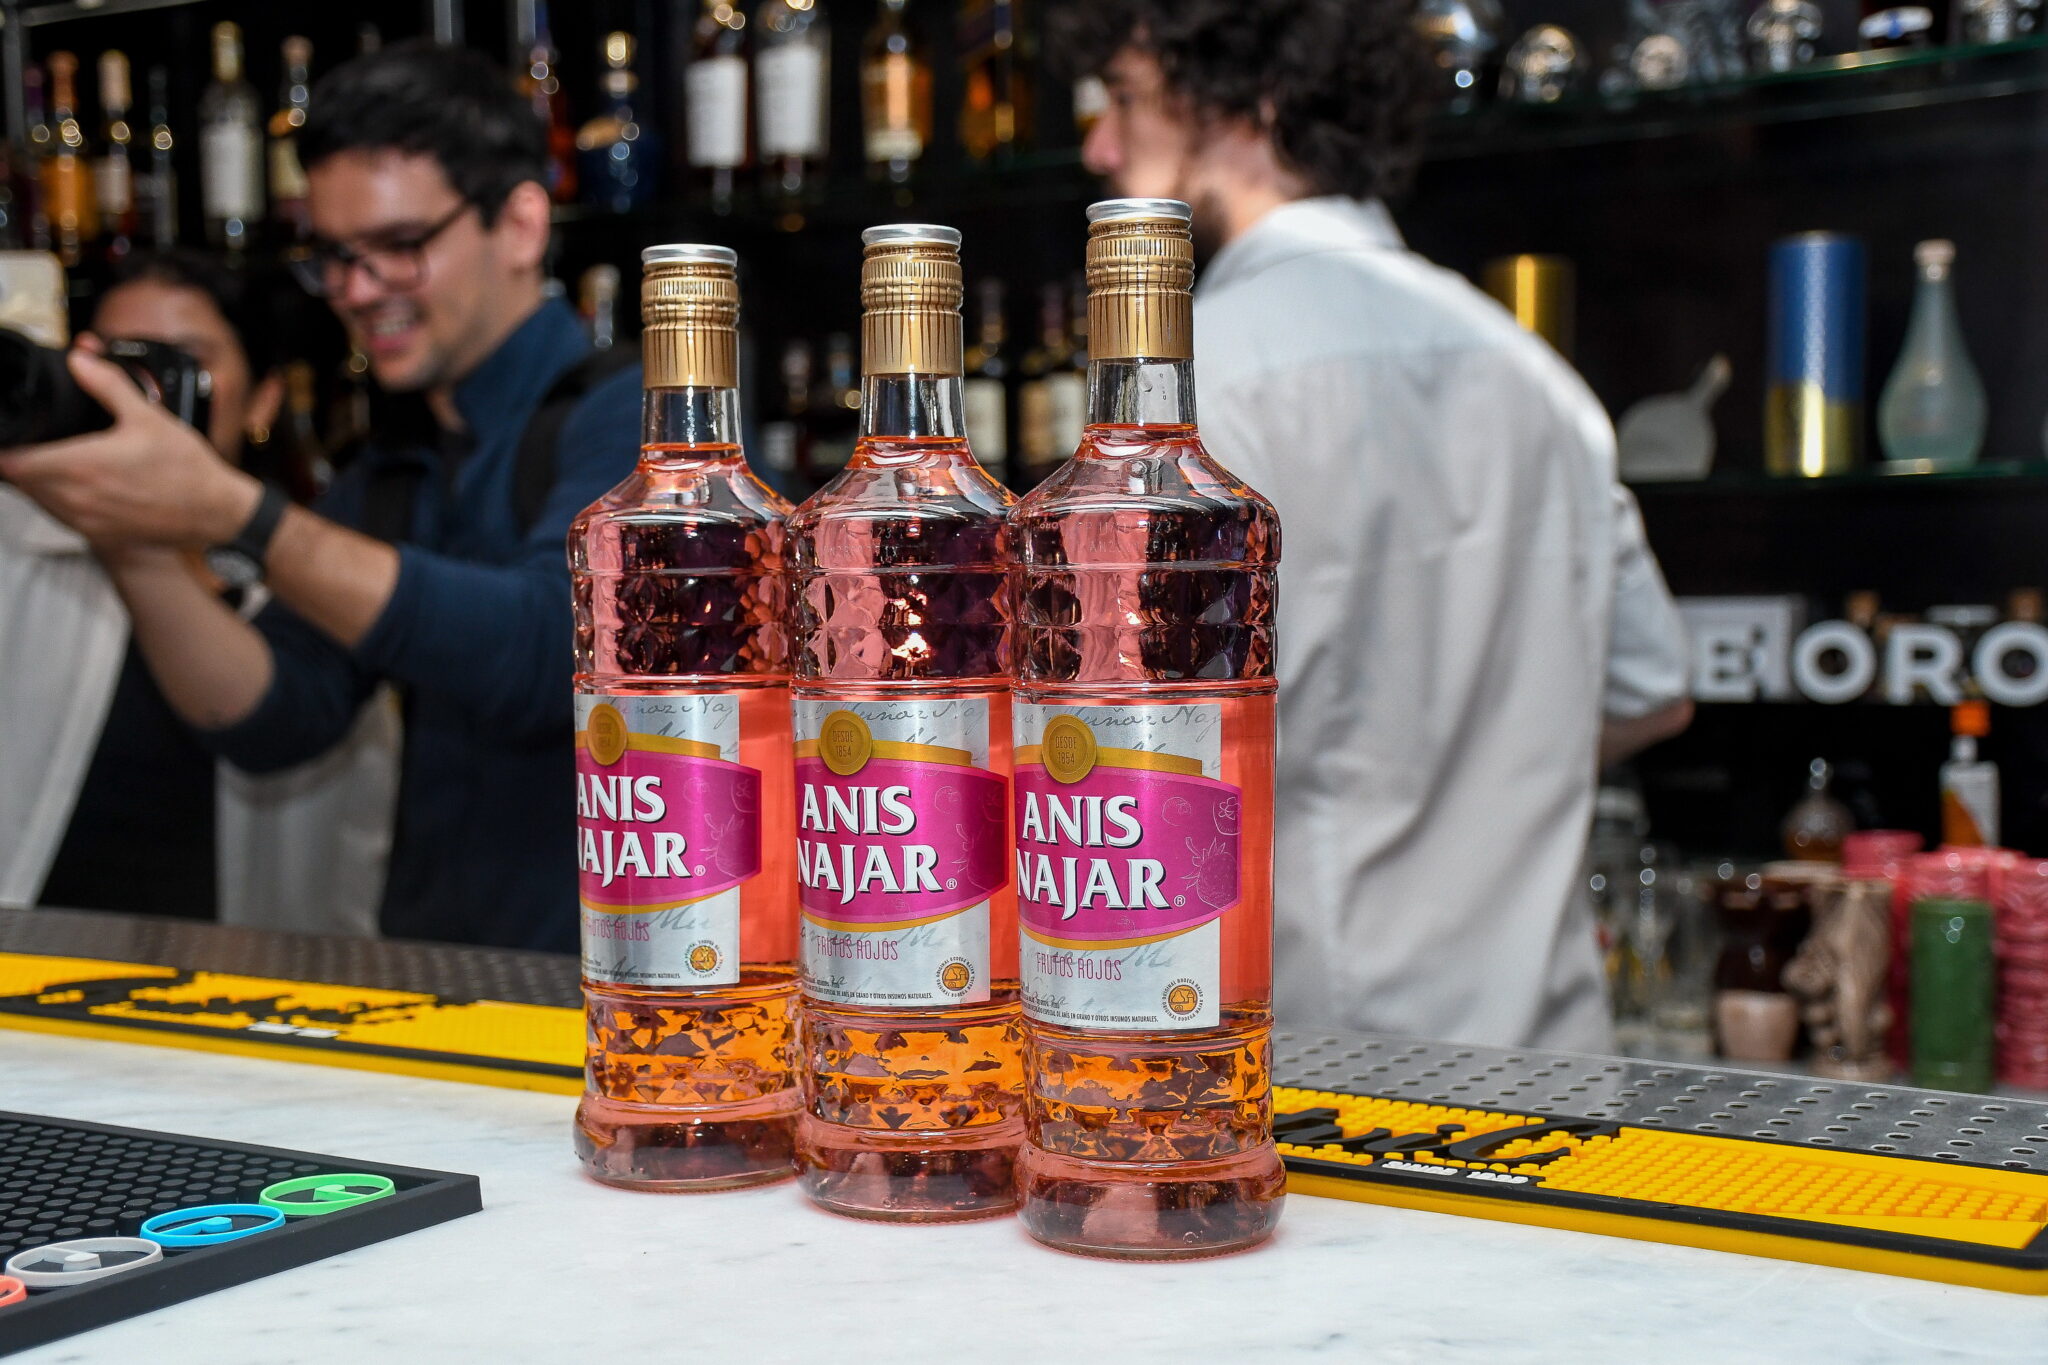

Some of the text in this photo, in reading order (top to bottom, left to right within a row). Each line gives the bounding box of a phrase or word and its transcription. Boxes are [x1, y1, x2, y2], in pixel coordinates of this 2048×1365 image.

[832, 730, 855, 743] DESDE
[1055, 735, 1078, 750] DESDE
[835, 745, 853, 757] 1854
[1058, 751, 1076, 766] 1854
[577, 772, 668, 823] ANIS
[801, 783, 917, 836] ANIS
[1022, 791, 1144, 849] ANIS
[796, 837, 945, 905] NAJAR
[1016, 848, 1172, 921] NAJAR
[816, 935, 899, 961] FRUTOS ROJOS
[1036, 952, 1123, 981] FRUTOS ROJOS
[1077, 1013, 1090, 1021] GRANO
[1095, 1014, 1109, 1022] OTROS
[1110, 1014, 1131, 1023] INSUMOS
